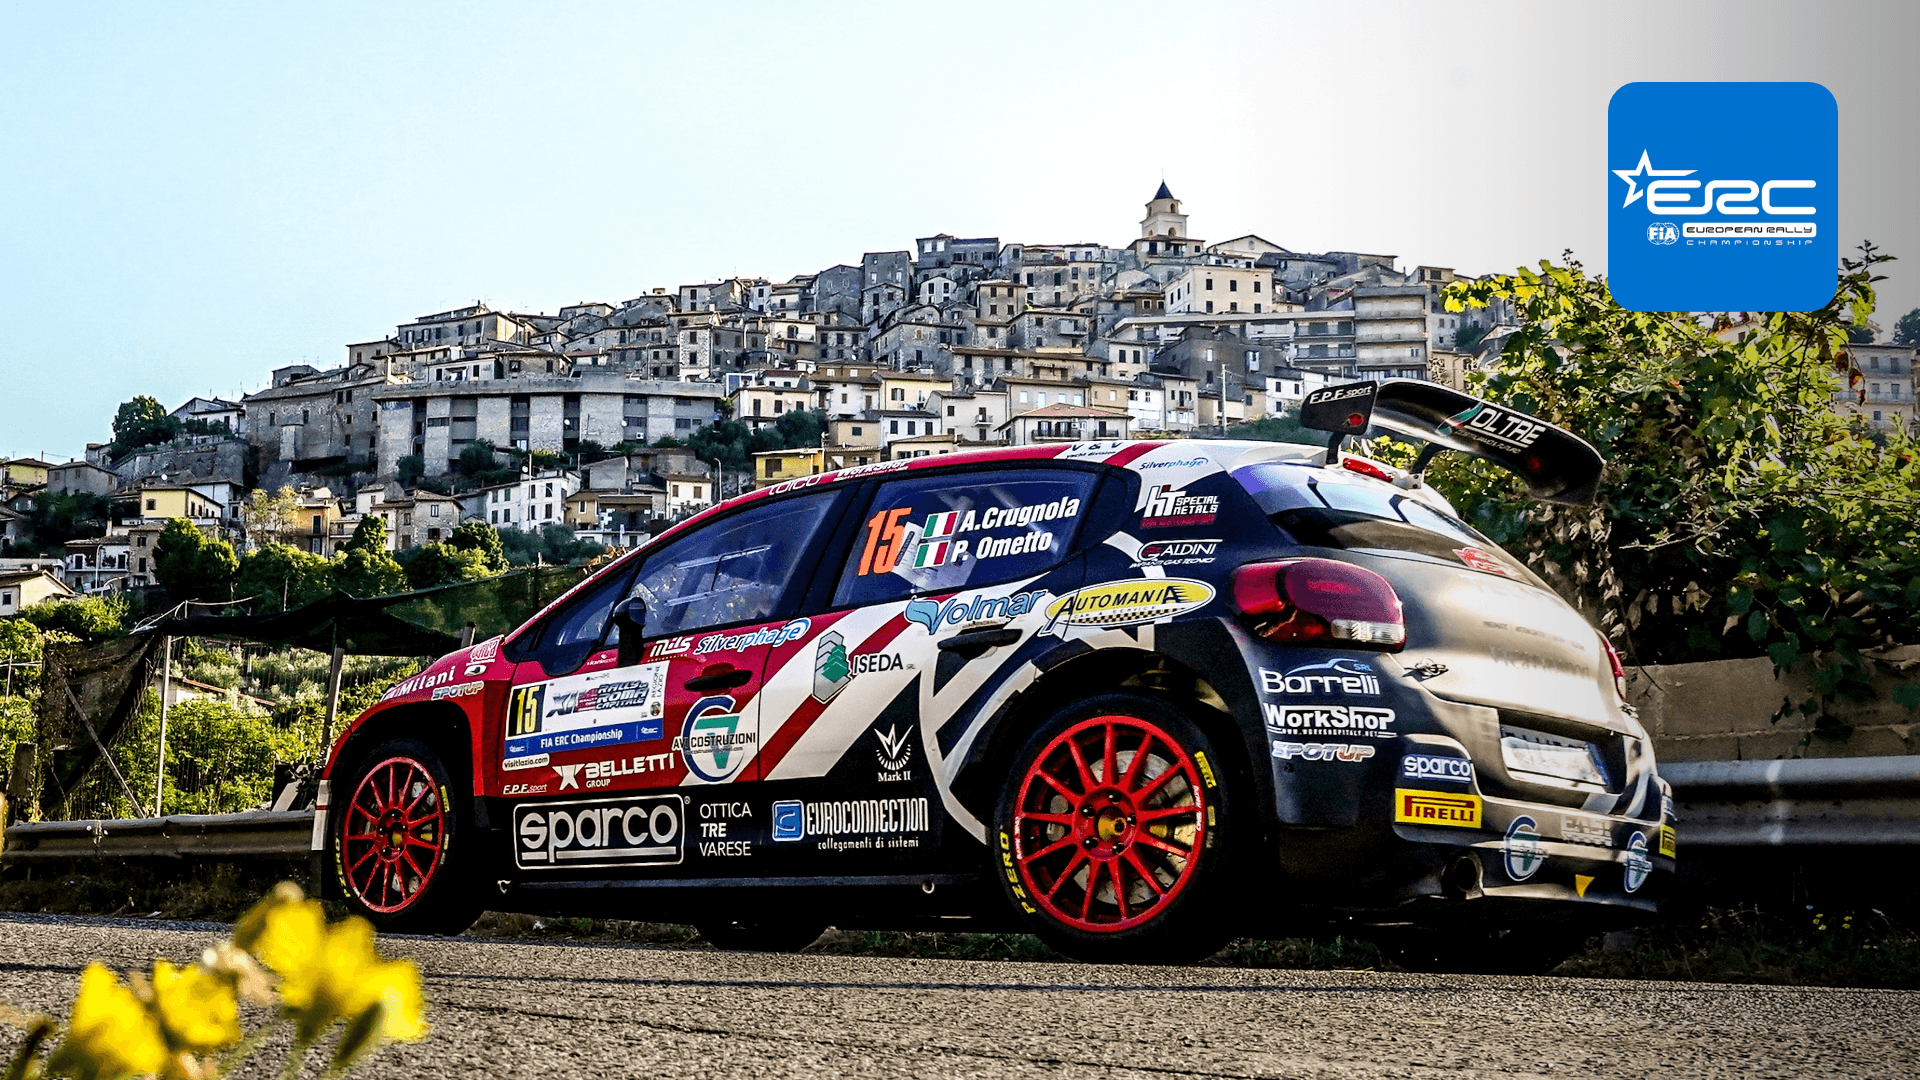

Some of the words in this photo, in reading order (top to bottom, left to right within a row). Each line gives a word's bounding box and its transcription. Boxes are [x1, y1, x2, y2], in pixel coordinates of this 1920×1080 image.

[1072, 443, 1084, 451] V
[1139, 459, 1204, 470] Silverphage
[1175, 495, 1220, 506] SPECIAL
[858, 507, 912, 576] 15
[951, 540, 969, 563] P.
[976, 532, 1053, 560] Ometto
[906, 590, 1048, 635] Volmar
[1043, 586, 1184, 633] AUTOMANIA
[693, 621, 805, 655] Silverphage
[853, 652, 903, 675] ISEDA
[431, 680, 484, 700] SPOTUP
[597, 688, 649, 703] ROMA
[598, 680, 641, 694] RALLY
[516, 686, 539, 734] 15
[541, 737, 553, 748] FIA
[555, 734, 569, 746] ERC
[571, 728, 623, 744] Championship
[691, 732, 756, 748] COSTRUZIONI
[504, 755, 548, 769] visitlazio.com
[585, 752, 675, 778] BELLETTI
[1404, 756, 1471, 780] sparco
[586, 778, 611, 788] GROUP
[878, 772, 901, 783] Mark
[903, 771, 911, 782] II
[700, 803, 752, 818] OTTICA
[1404, 795, 1475, 822] PIRELLI
[520, 805, 678, 862] sparco
[700, 823, 727, 837] TRE
[699, 841, 752, 857] VARESE
[818, 836, 873, 852] collegamenti
[875, 836, 884, 849] di
[888, 836, 919, 849] sistemi
